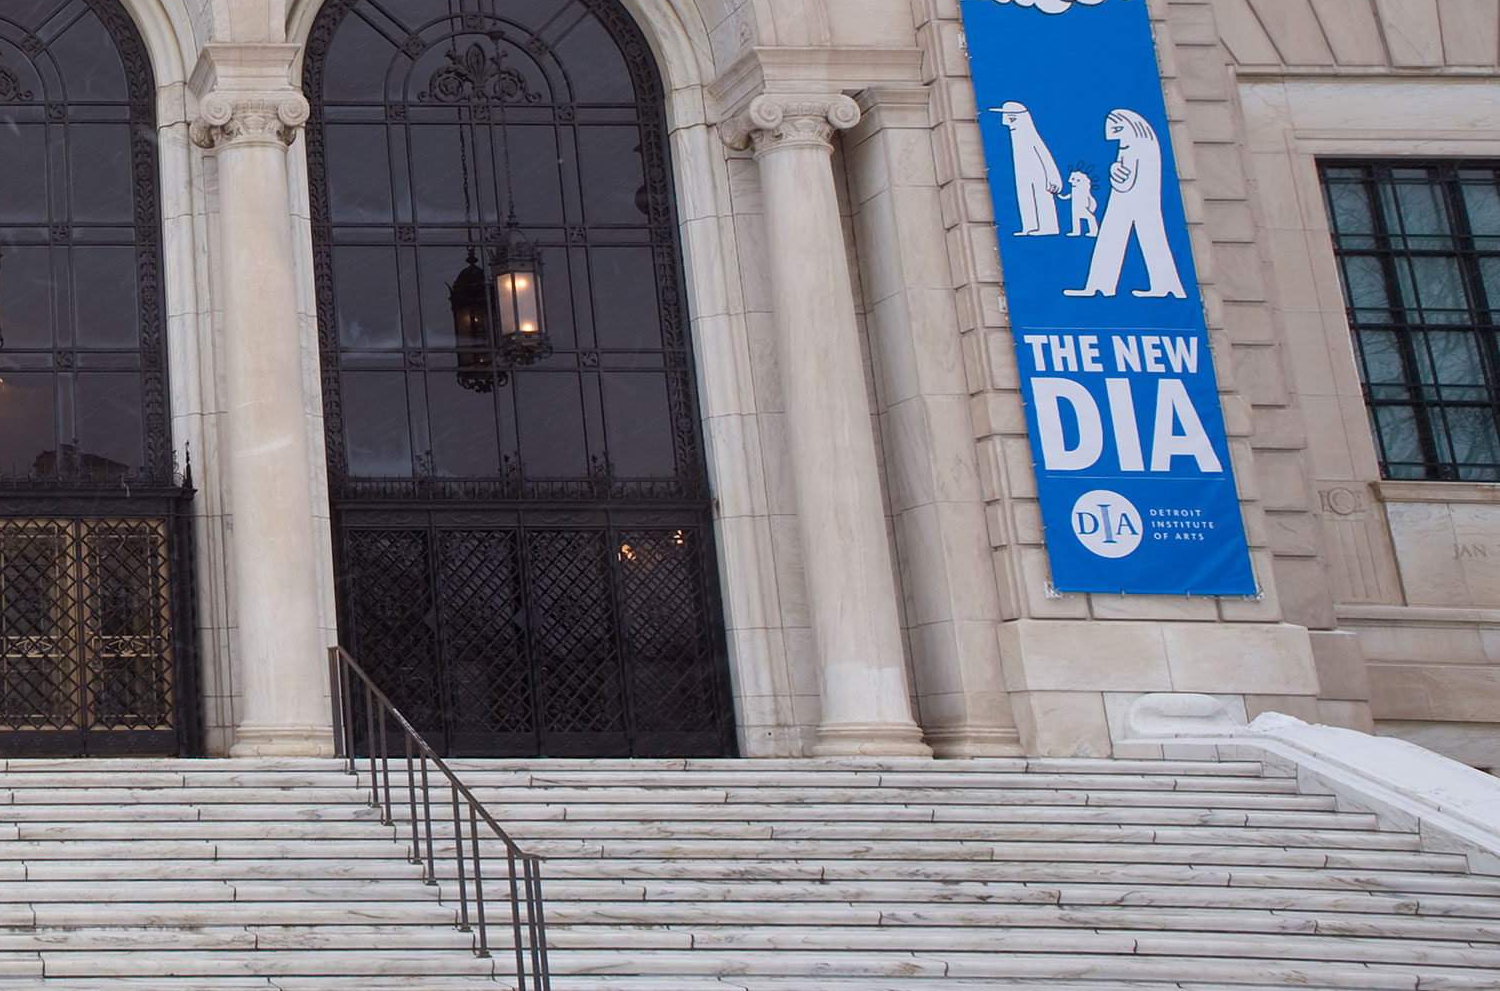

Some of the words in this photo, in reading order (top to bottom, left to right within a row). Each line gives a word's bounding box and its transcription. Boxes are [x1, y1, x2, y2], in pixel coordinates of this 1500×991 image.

[1024, 335, 1103, 372] THE
[1112, 336, 1197, 373] NEW
[1030, 376, 1224, 473] DIA
[1149, 509, 1201, 517] DETROIT
[1076, 504, 1139, 543] DIA
[1152, 521, 1214, 529] INSTITUTE
[1153, 532, 1168, 540] OF
[1175, 533, 1204, 541] ARTS
[1452, 543, 1487, 560] JAN
